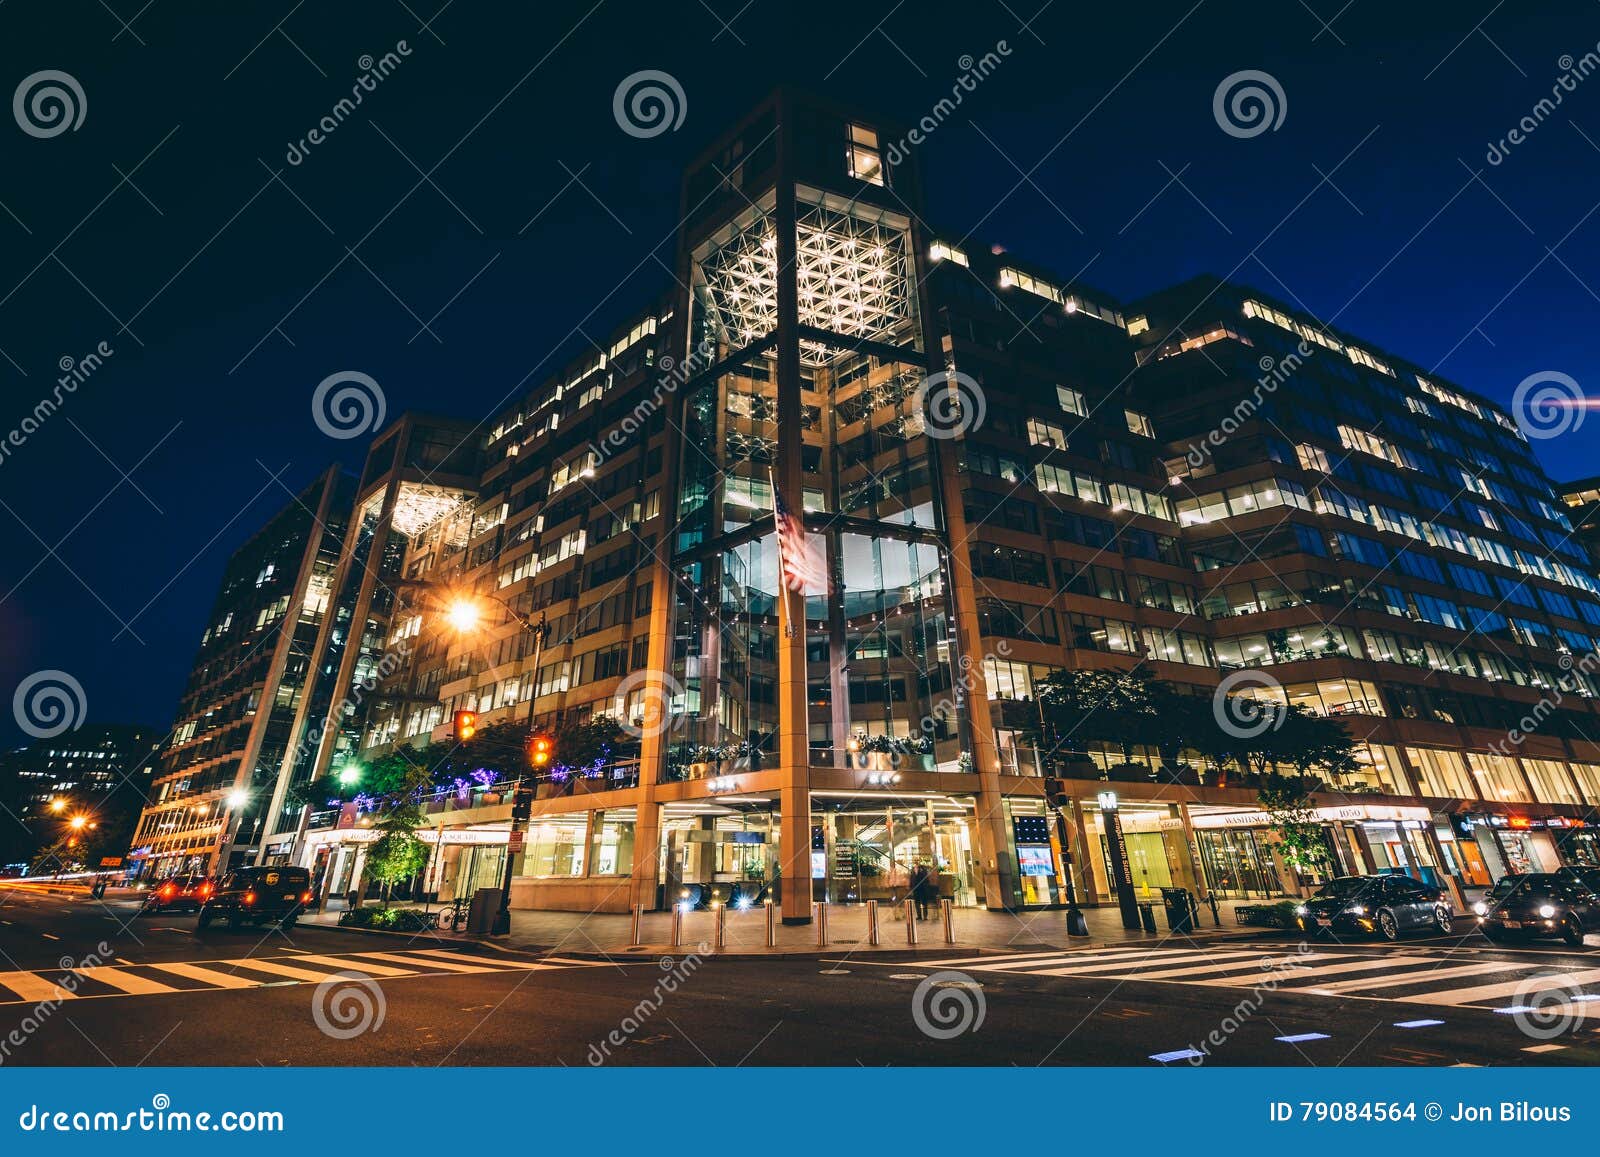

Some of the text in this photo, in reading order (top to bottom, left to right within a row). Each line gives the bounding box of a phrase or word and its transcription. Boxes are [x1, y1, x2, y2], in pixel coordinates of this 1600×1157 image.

[1098, 792, 1117, 809] M
[1338, 807, 1361, 818] 1050
[1118, 840, 1126, 859] North
[1122, 860, 1131, 884] Station
